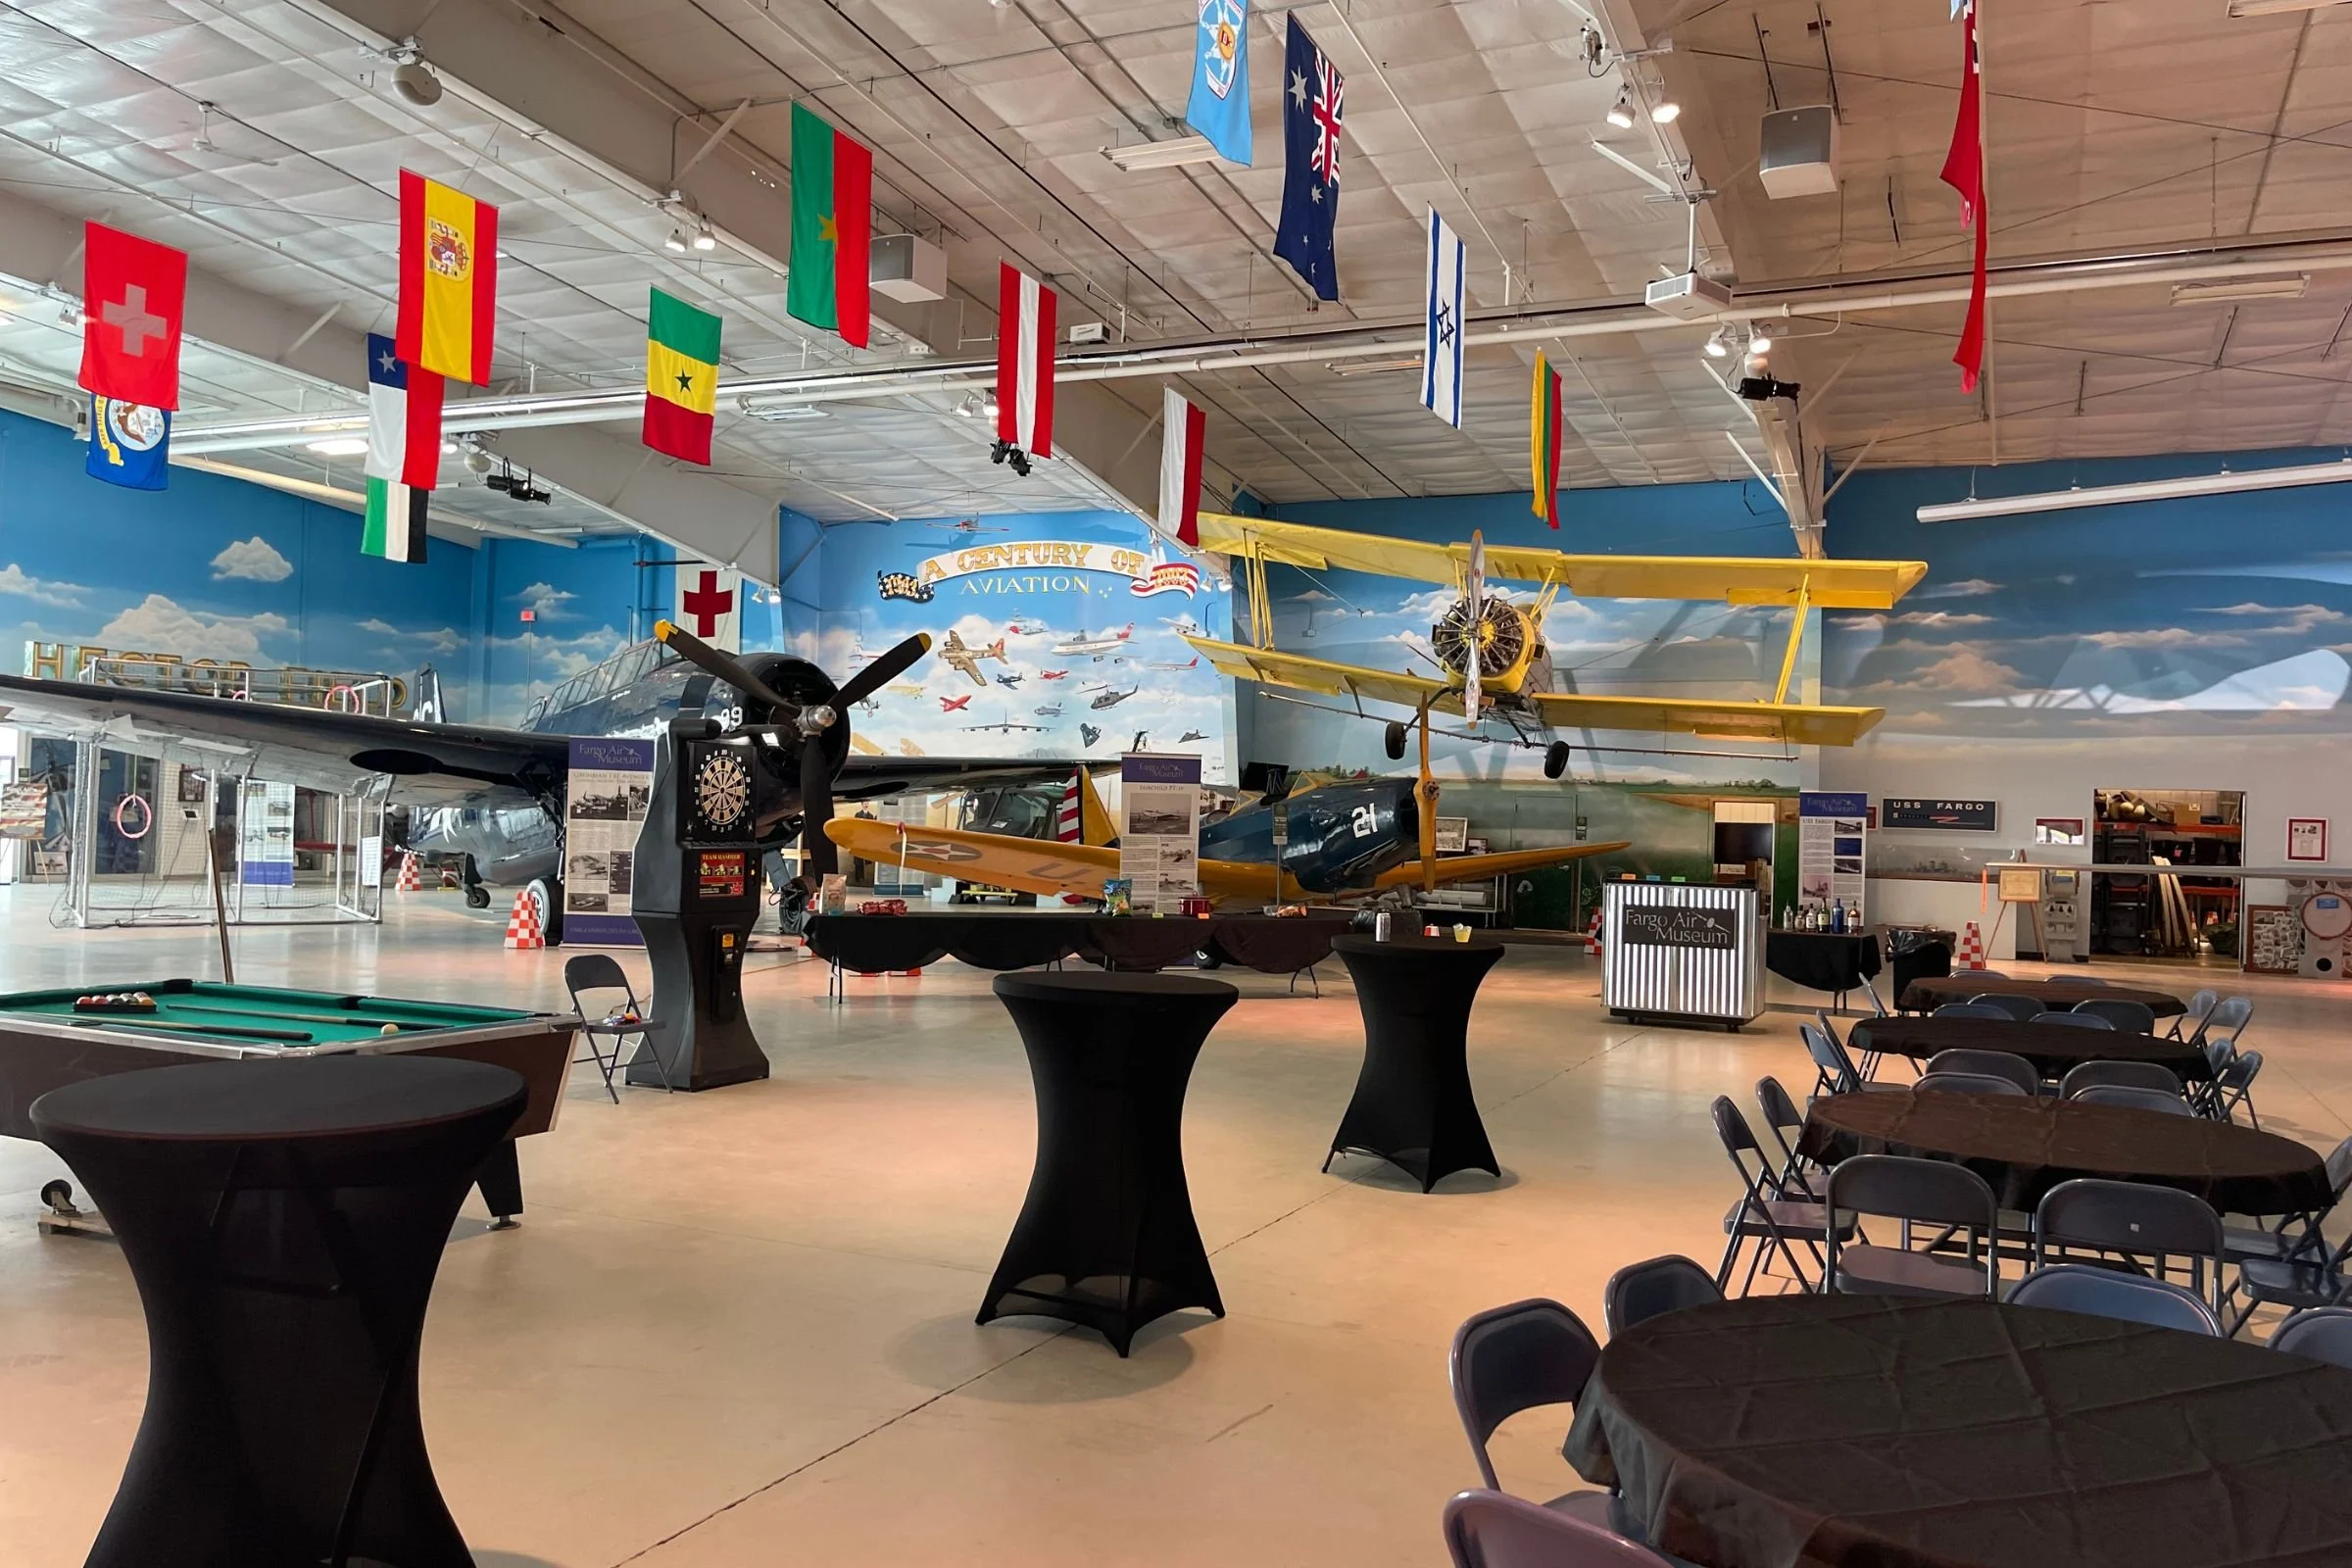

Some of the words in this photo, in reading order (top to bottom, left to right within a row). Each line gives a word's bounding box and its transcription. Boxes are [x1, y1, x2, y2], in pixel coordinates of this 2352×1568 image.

[923, 560, 948, 583] A
[956, 542, 1095, 573] CENTURY
[1110, 549, 1146, 574] OF
[887, 577, 918, 596] 1903
[959, 575, 1090, 595] AVIATION
[579, 744, 607, 758] Fargo
[608, 745, 624, 756] Air
[598, 754, 643, 764] Museum
[1351, 803, 1378, 839] 21
[1625, 908, 1668, 932] Fargo
[1672, 911, 1698, 928] Air
[1655, 927, 1729, 944] Museum
